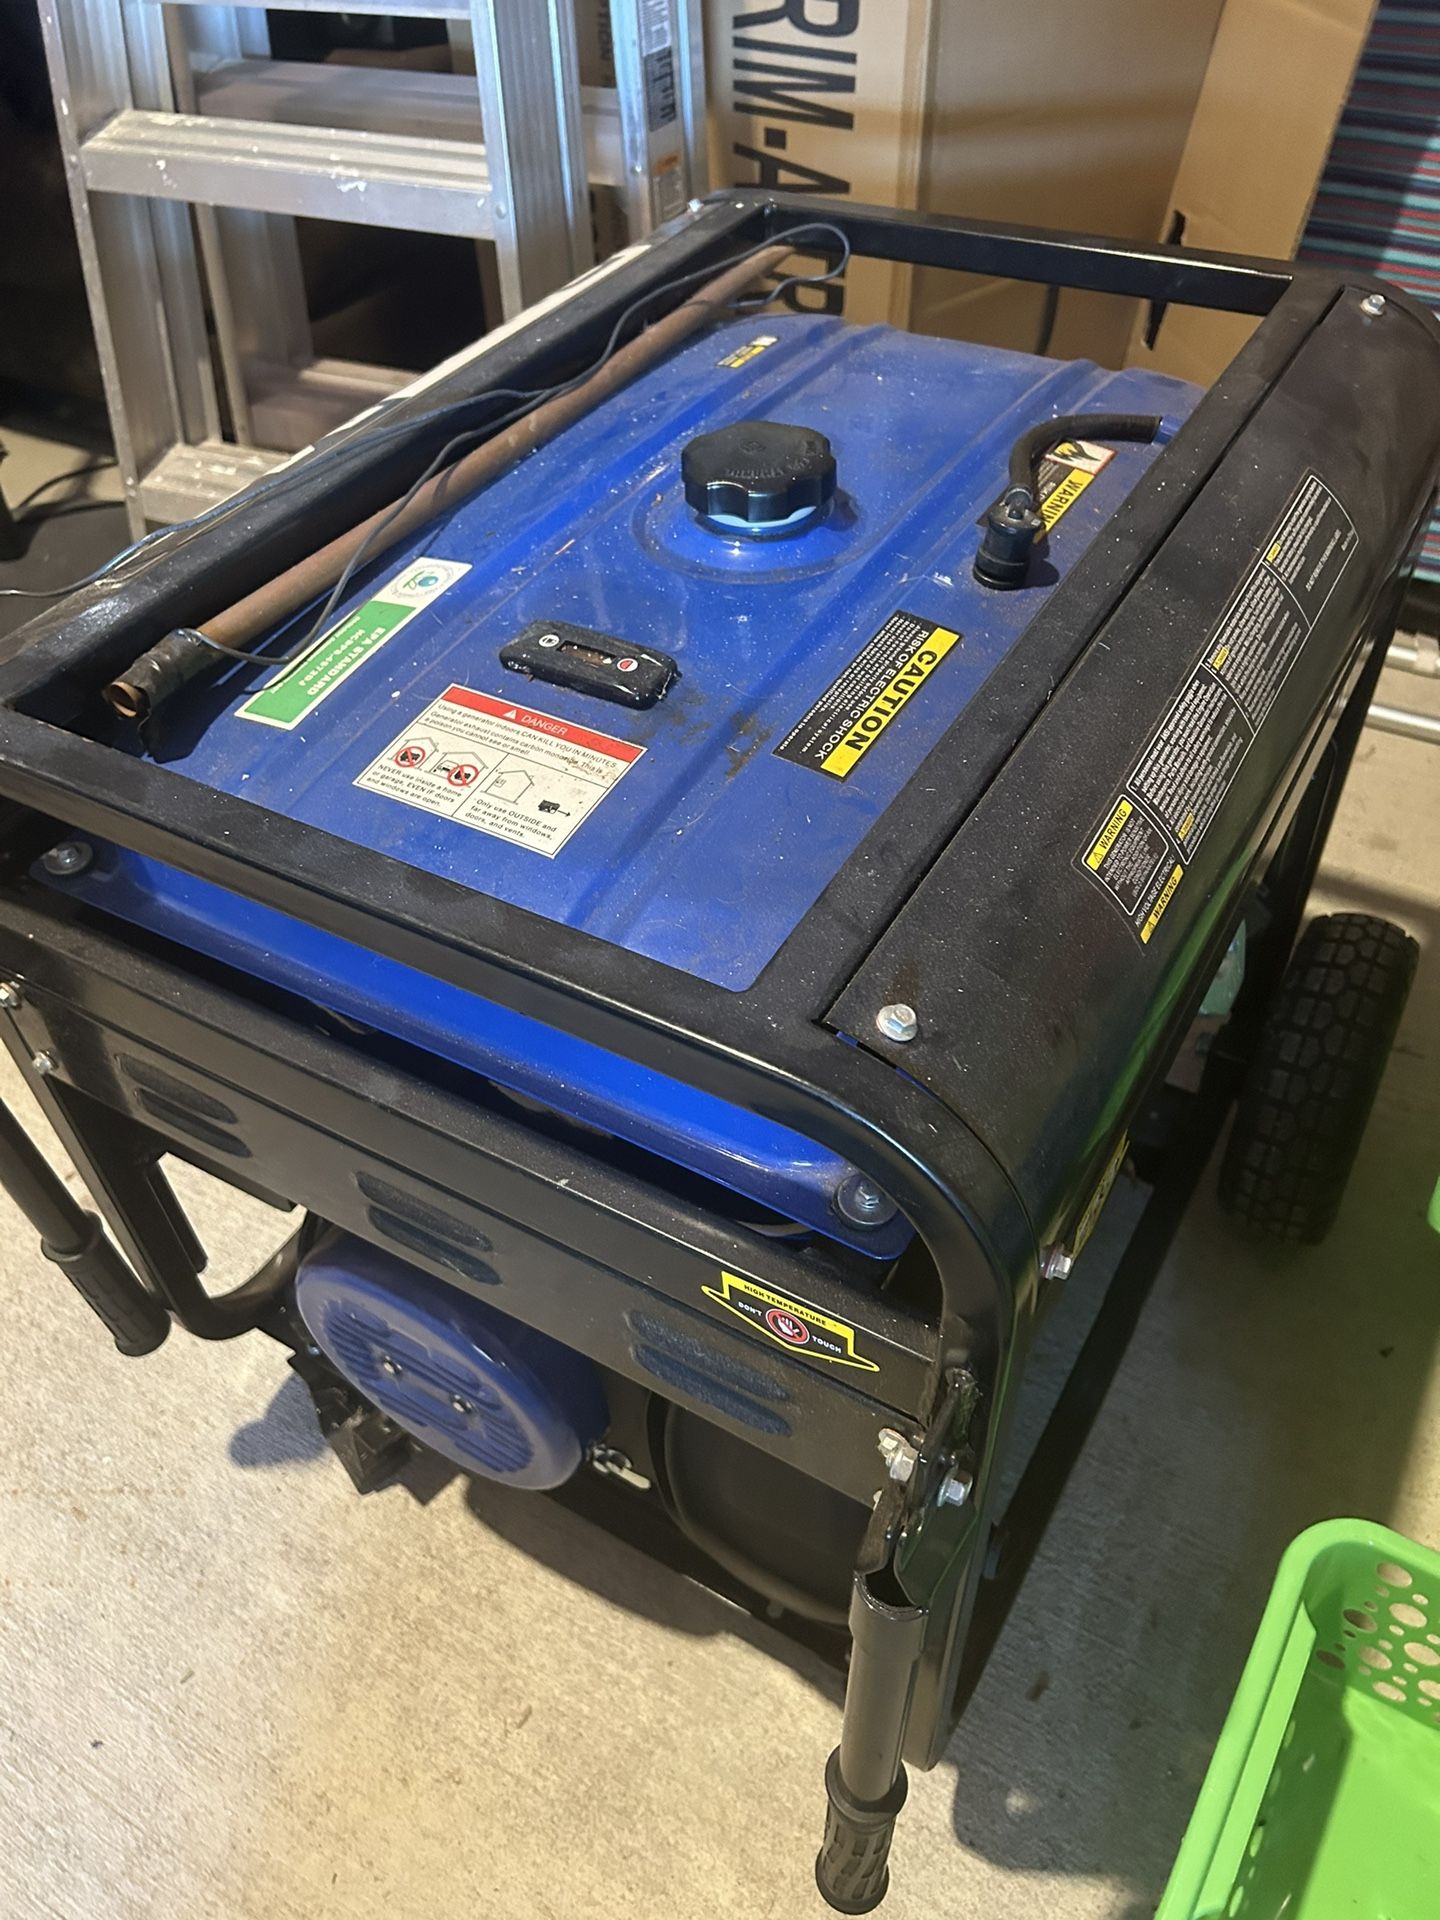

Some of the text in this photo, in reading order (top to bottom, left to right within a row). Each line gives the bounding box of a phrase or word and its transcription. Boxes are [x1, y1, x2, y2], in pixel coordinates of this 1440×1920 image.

[1042, 479, 1083, 526] WARNIN
[362, 627, 385, 644] EPA
[904, 625, 920, 642] Always
[888, 642, 905, 661] ground
[307, 646, 364, 695] STANDARD
[869, 660, 890, 682] properly
[815, 630, 929, 760] RISK OF ELECTRIC SHOCK
[845, 651, 937, 751] CAUTION
[854, 682, 871, 700] before
[428, 718, 453, 730] poison
[451, 726, 466, 734] you
[464, 730, 490, 742] cannot
[488, 738, 502, 746] see
[437, 703, 458, 715] Using
[461, 712, 496, 726] generator
[494, 722, 521, 736] indoors
[520, 730, 539, 741] CAN
[536, 736, 554, 747] KILL
[554, 742, 573, 753] YOU
[571, 748, 582, 756] IN
[521, 715, 568, 735] DANGER
[430, 711, 464, 725] Generator
[462, 722, 492, 735] exhaust
[489, 731, 520, 745] contains
[519, 741, 545, 753] carbon
[580, 761, 596, 772] This
[595, 766, 603, 775] is
[366, 776, 381, 785] and
[379, 781, 410, 795] windows
[409, 792, 422, 800] are
[377, 763, 402, 776] NEVER
[401, 773, 415, 781] use
[414, 776, 437, 788] inside
[441, 786, 463, 798] home
[406, 781, 427, 793] EVEN
[434, 792, 456, 804] doors
[470, 804, 482, 813] far
[481, 810, 501, 821] away
[501, 816, 519, 827] from
[475, 798, 558, 833] Only use OUTSIDE and
[488, 821, 504, 830] and
[1098, 808, 1127, 850] WARNING
[1153, 876, 1177, 919] WARNING
[744, 1284, 827, 1327] HIGH TEMPERATURE
[738, 1301, 842, 1354] DON'T TOUCH
